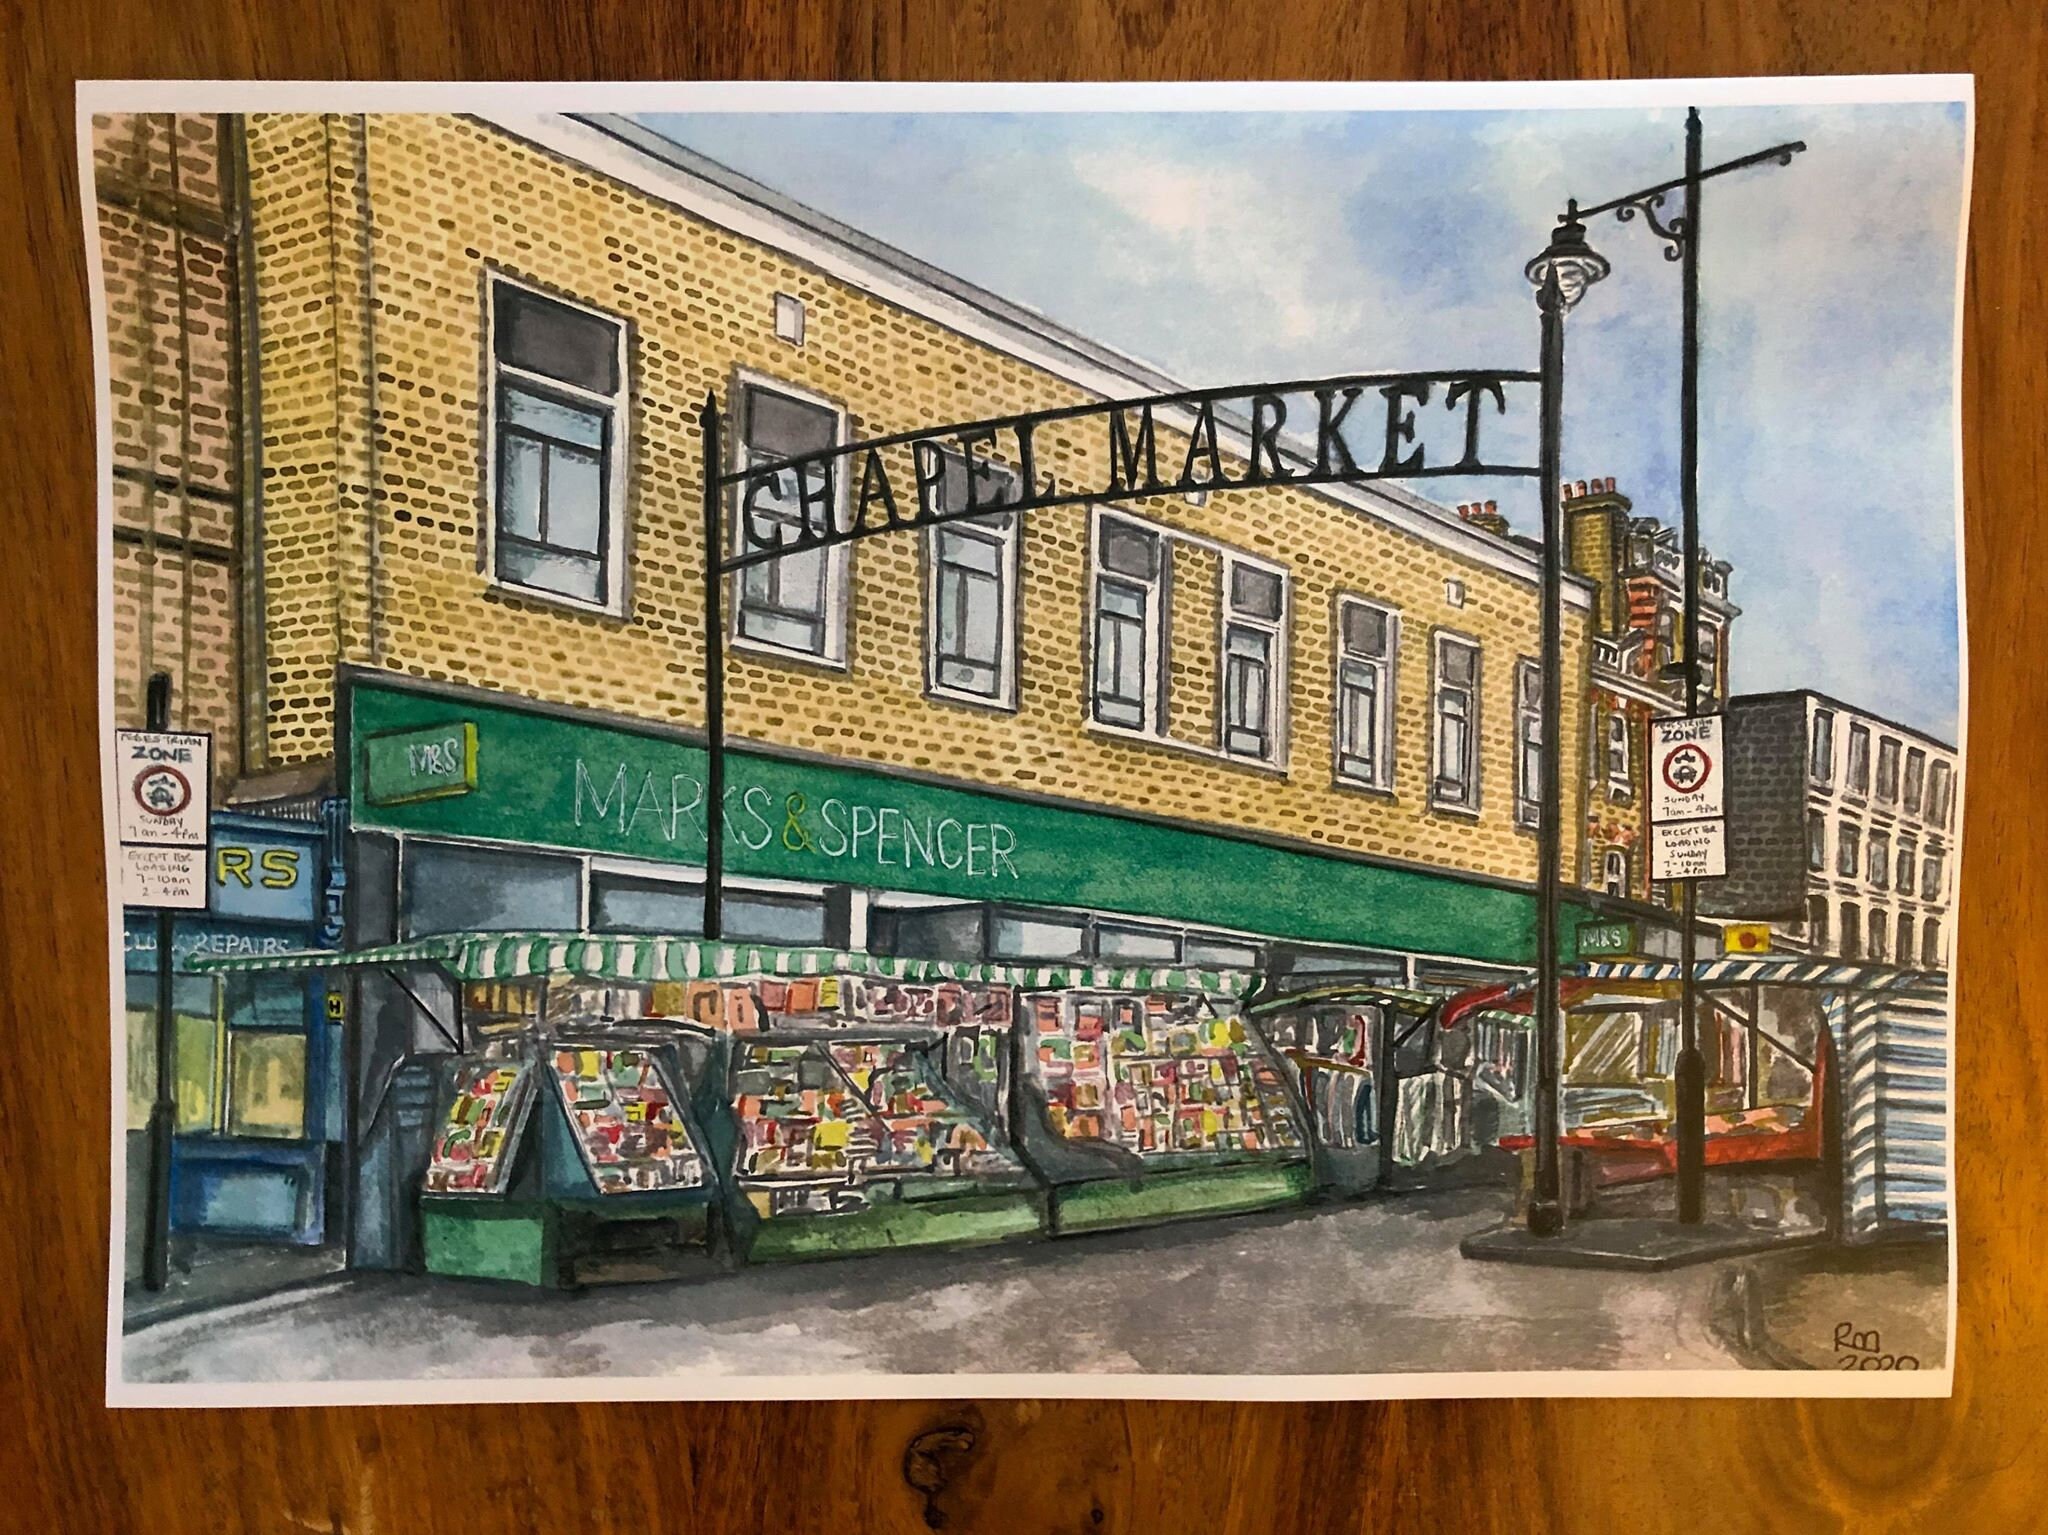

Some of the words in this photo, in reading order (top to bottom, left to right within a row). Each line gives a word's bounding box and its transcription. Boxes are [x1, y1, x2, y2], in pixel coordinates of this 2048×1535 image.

[743, 422, 1056, 550] CHAPEL
[1108, 379, 1506, 494] MARKET
[1661, 726, 1711, 743] ZONE
[131, 745, 192, 763] ZONE
[408, 737, 459, 777] M&S
[1664, 793, 1705, 804] SUNDAY
[139, 814, 184, 829] SUNDAY
[819, 798, 1019, 880] SPENCER
[1661, 826, 1700, 836] EXCEPT
[1665, 837, 1711, 848] LOADING
[1582, 927, 1622, 948] M&S
